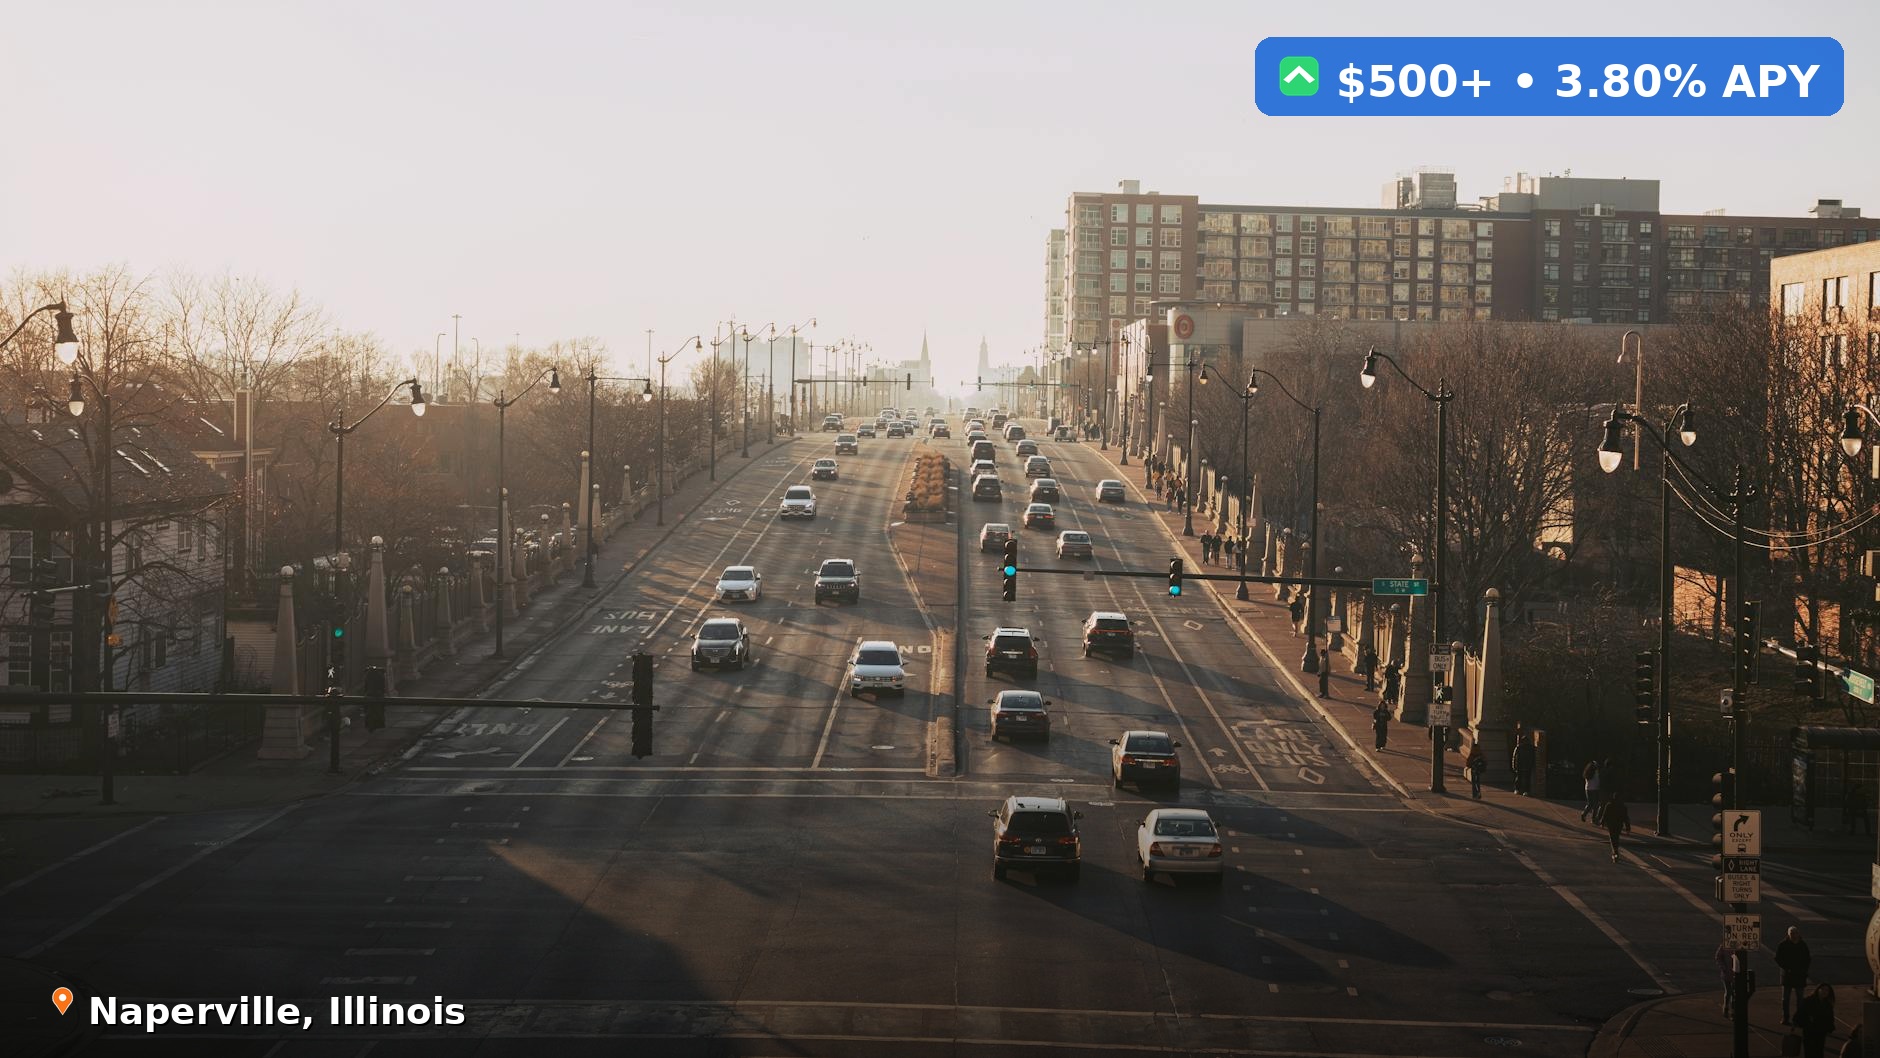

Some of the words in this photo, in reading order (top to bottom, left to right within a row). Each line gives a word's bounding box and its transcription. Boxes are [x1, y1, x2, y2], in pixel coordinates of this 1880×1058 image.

[1390, 580, 1409, 588] STATE
[1230, 725, 1315, 741] LANE
[1244, 740, 1322, 755] ONLY
[1254, 752, 1331, 767] BUS
[1735, 916, 1749, 924] NO
[1732, 924, 1753, 932] TURN
[1742, 932, 1758, 940] RED
